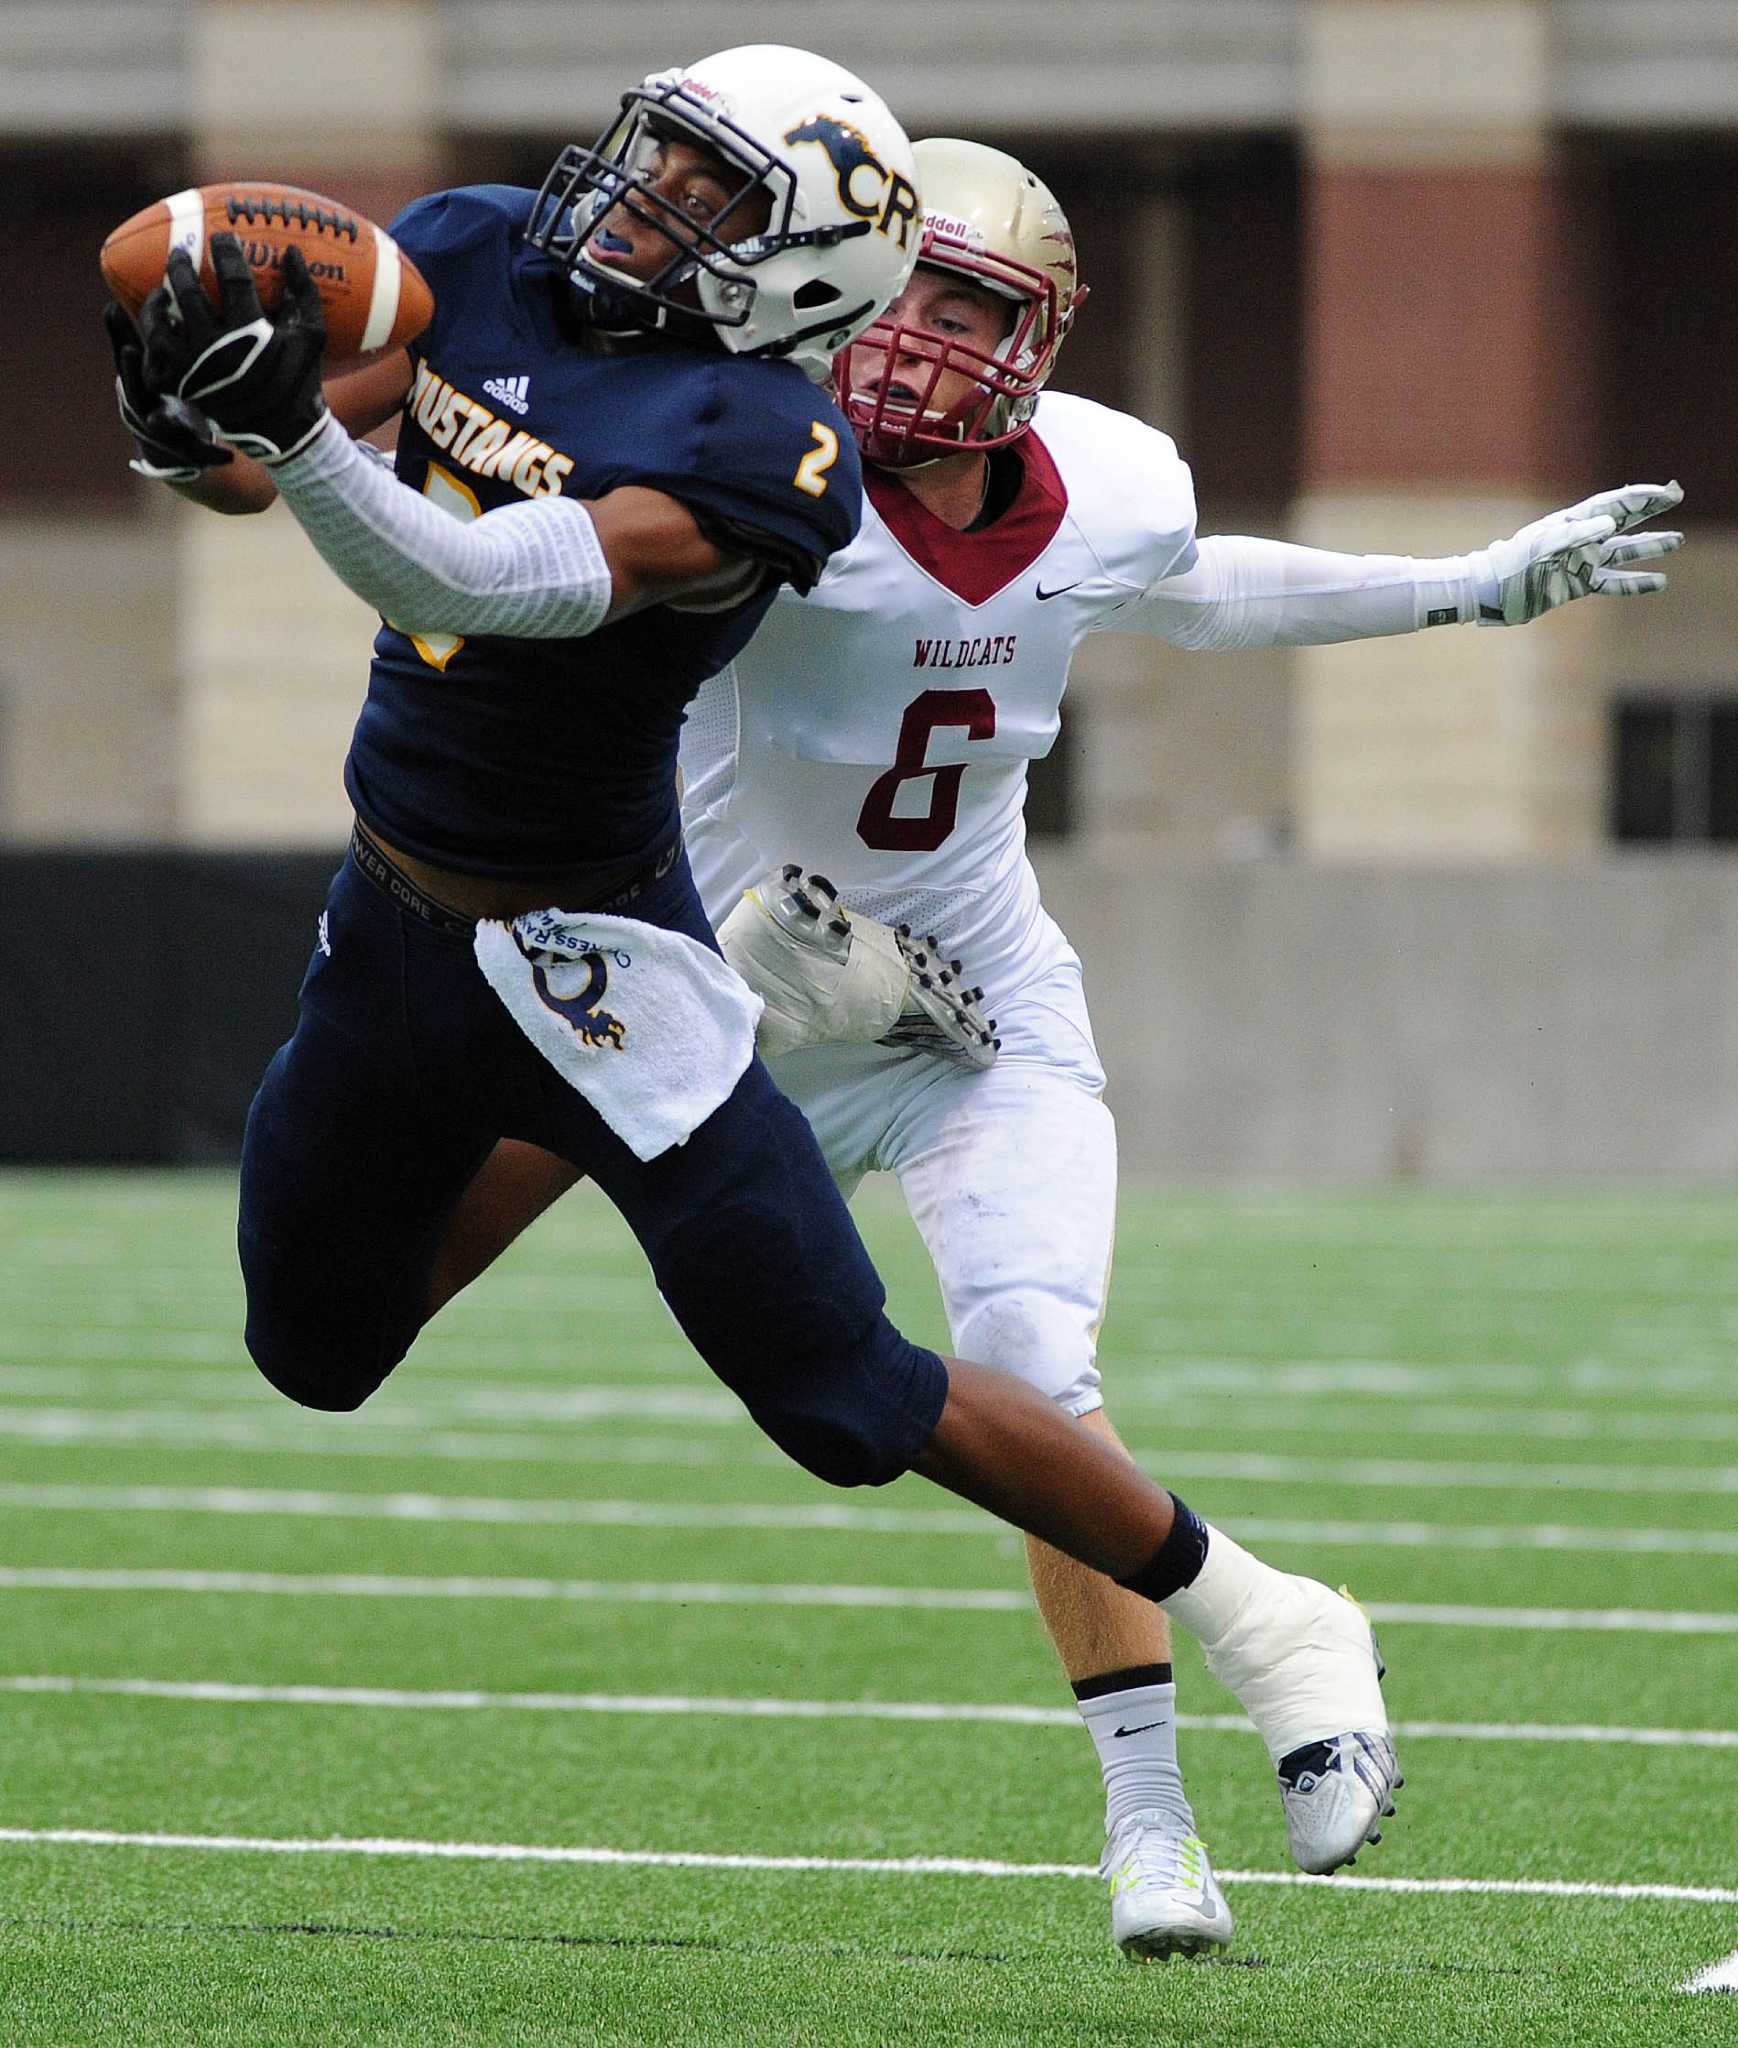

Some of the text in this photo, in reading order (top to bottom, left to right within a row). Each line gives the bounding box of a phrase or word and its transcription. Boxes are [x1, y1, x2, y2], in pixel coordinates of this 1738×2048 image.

[836, 151, 921, 251] CR
[926, 215, 967, 238] ddell
[239, 238, 345, 283] Wion
[482, 378, 530, 416] adidas
[794, 421, 838, 497] 2
[913, 635, 1016, 668] WILDCATS
[856, 687, 996, 852] 6
[390, 880, 432, 920] CORE
